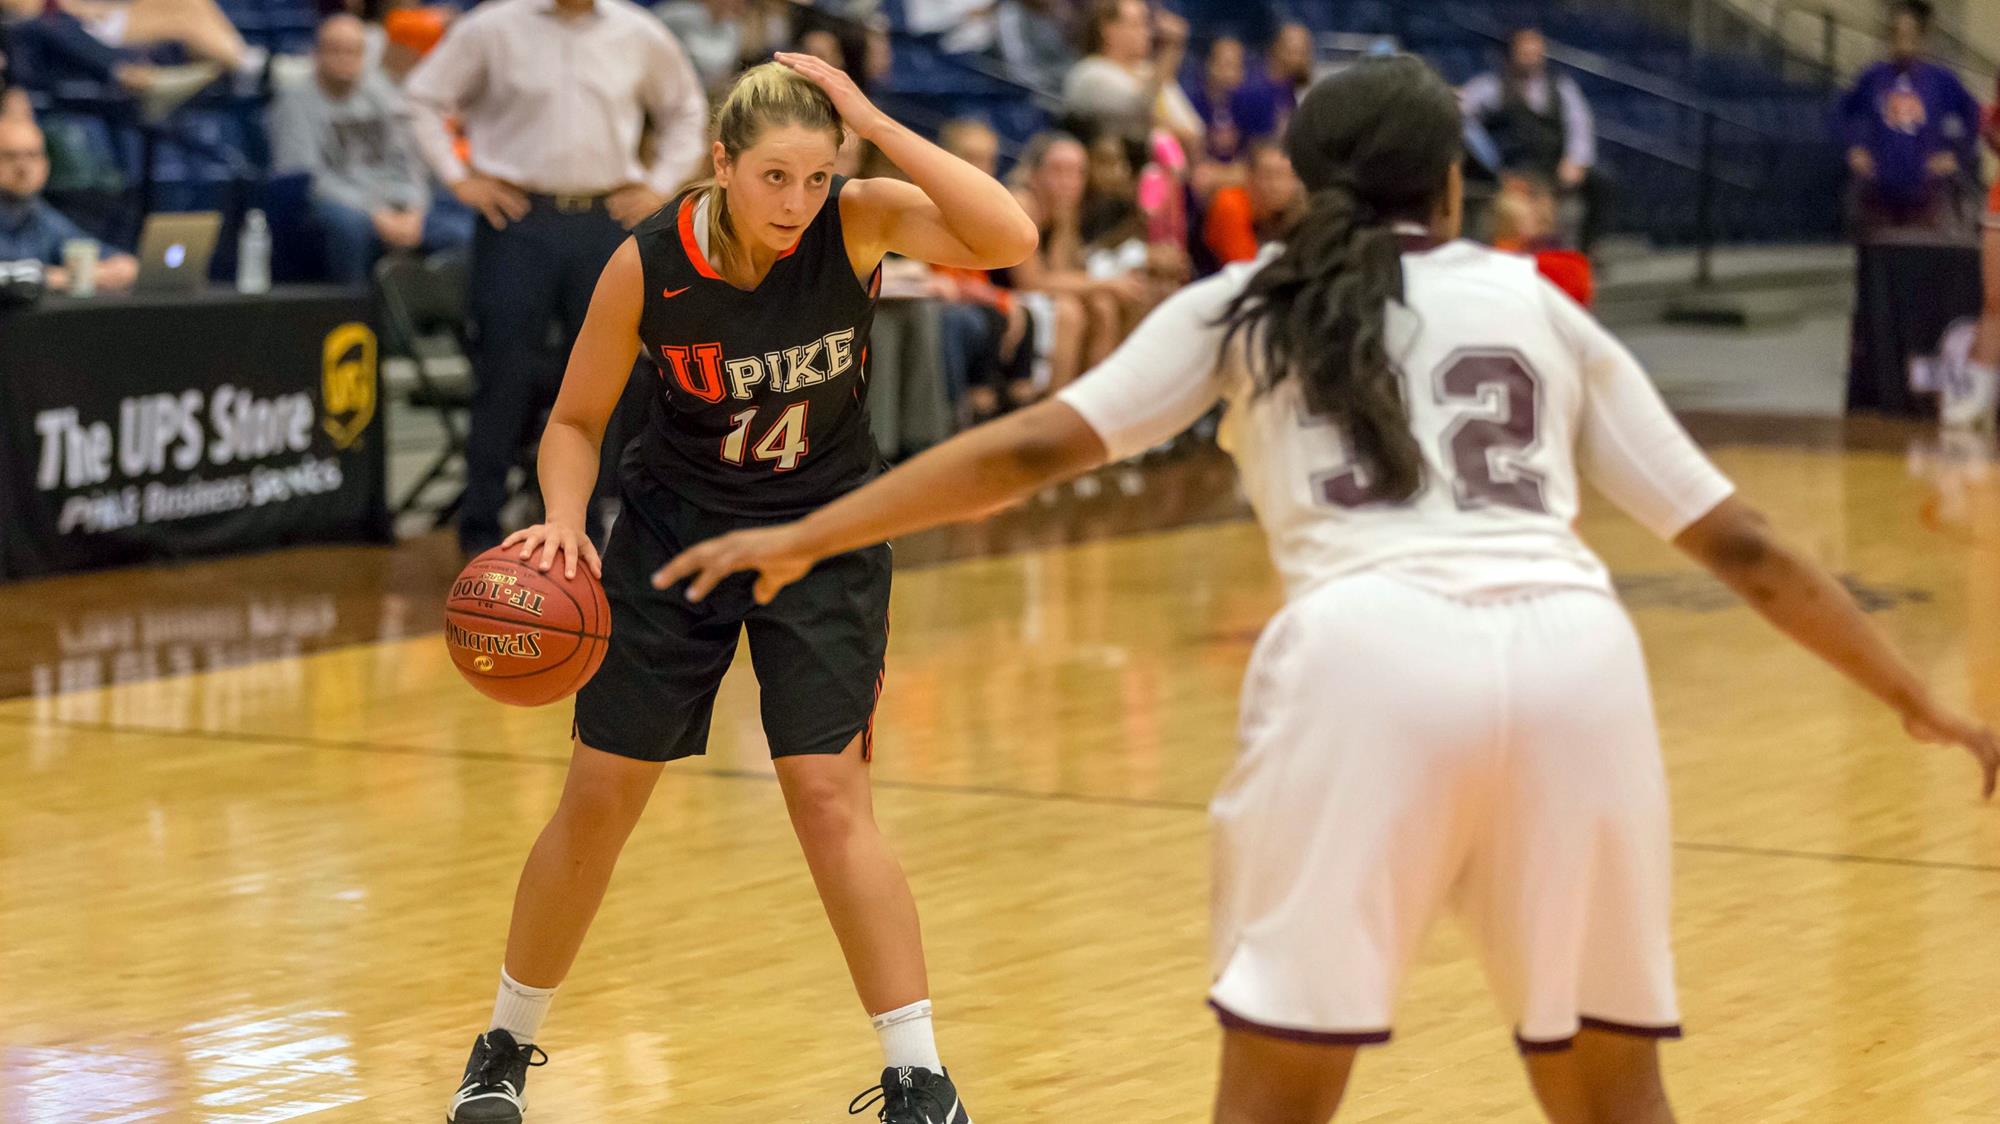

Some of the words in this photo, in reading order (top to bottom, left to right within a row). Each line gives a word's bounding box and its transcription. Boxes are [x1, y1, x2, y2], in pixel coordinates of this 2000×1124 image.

[661, 327, 855, 404] UPIKE
[34, 405, 113, 491] The
[118, 388, 204, 477] UPS
[208, 383, 314, 465] Store
[720, 400, 809, 473] 14
[452, 579, 545, 616] TF-1000
